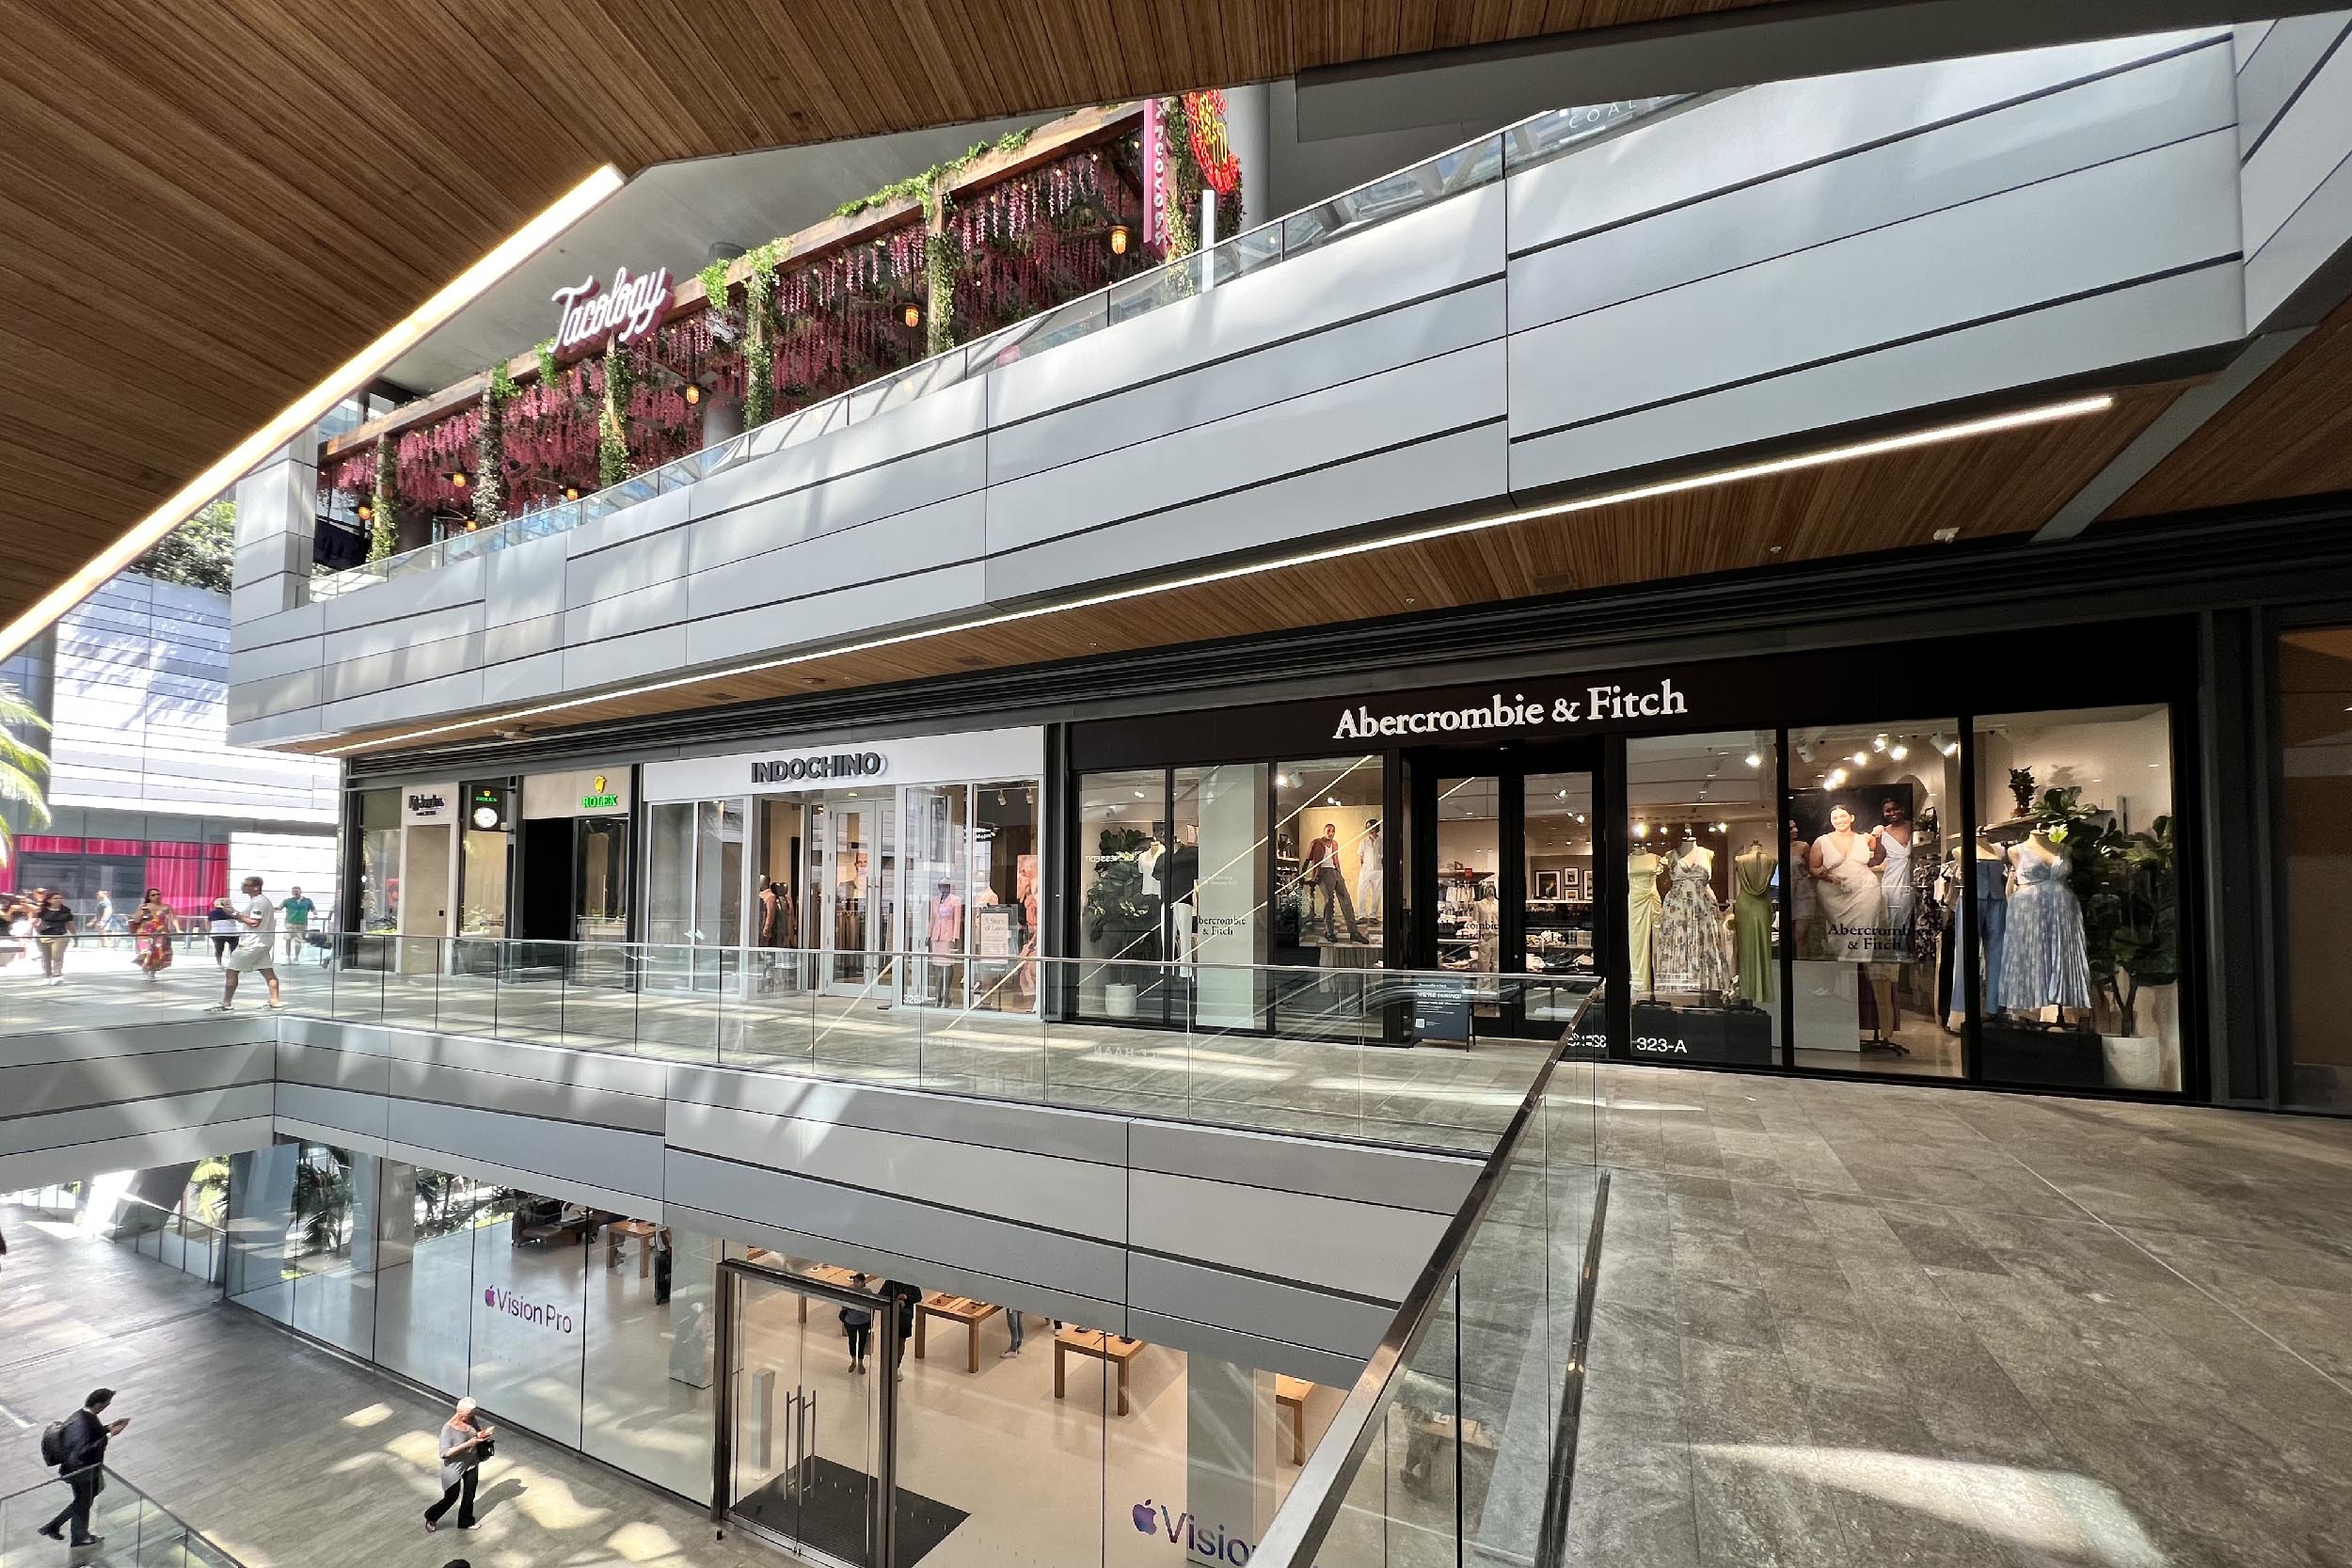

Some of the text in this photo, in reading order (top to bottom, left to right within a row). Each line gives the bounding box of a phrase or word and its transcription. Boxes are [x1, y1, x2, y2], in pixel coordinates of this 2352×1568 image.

[546, 265, 670, 354] Tacology
[1332, 678, 1689, 739] Abercrombie & Fitch
[751, 752, 882, 784] INDOCHINO
[581, 794, 619, 808] ROLEX
[1197, 914, 1247, 926] bercrombie
[1863, 937, 1901, 951] Fitch
[1636, 1037, 1688, 1053] 323-A
[497, 1288, 572, 1334] Vision Pro
[1160, 1504, 1257, 1567] Visio
